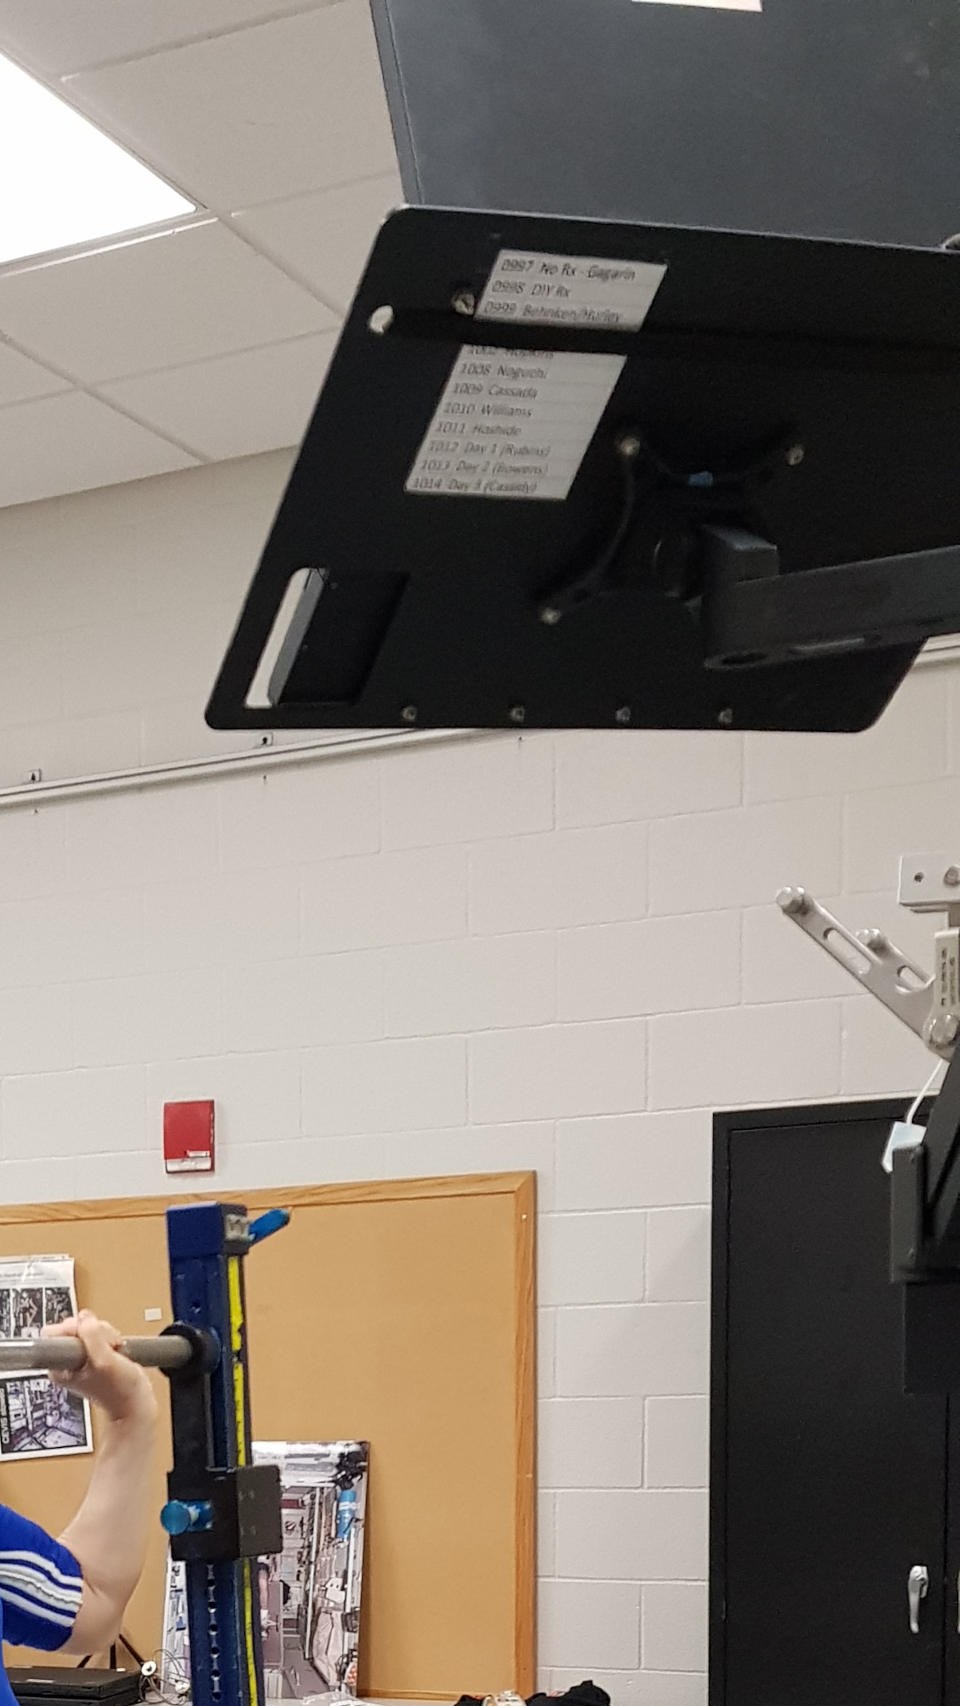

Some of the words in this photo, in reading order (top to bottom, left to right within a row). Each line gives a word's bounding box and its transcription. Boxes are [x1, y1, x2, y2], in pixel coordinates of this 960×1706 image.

[540, 262, 559, 276] No
[561, 263, 577, 276] Rx
[463, 442, 486, 457] Day
[455, 461, 480, 476] Day
